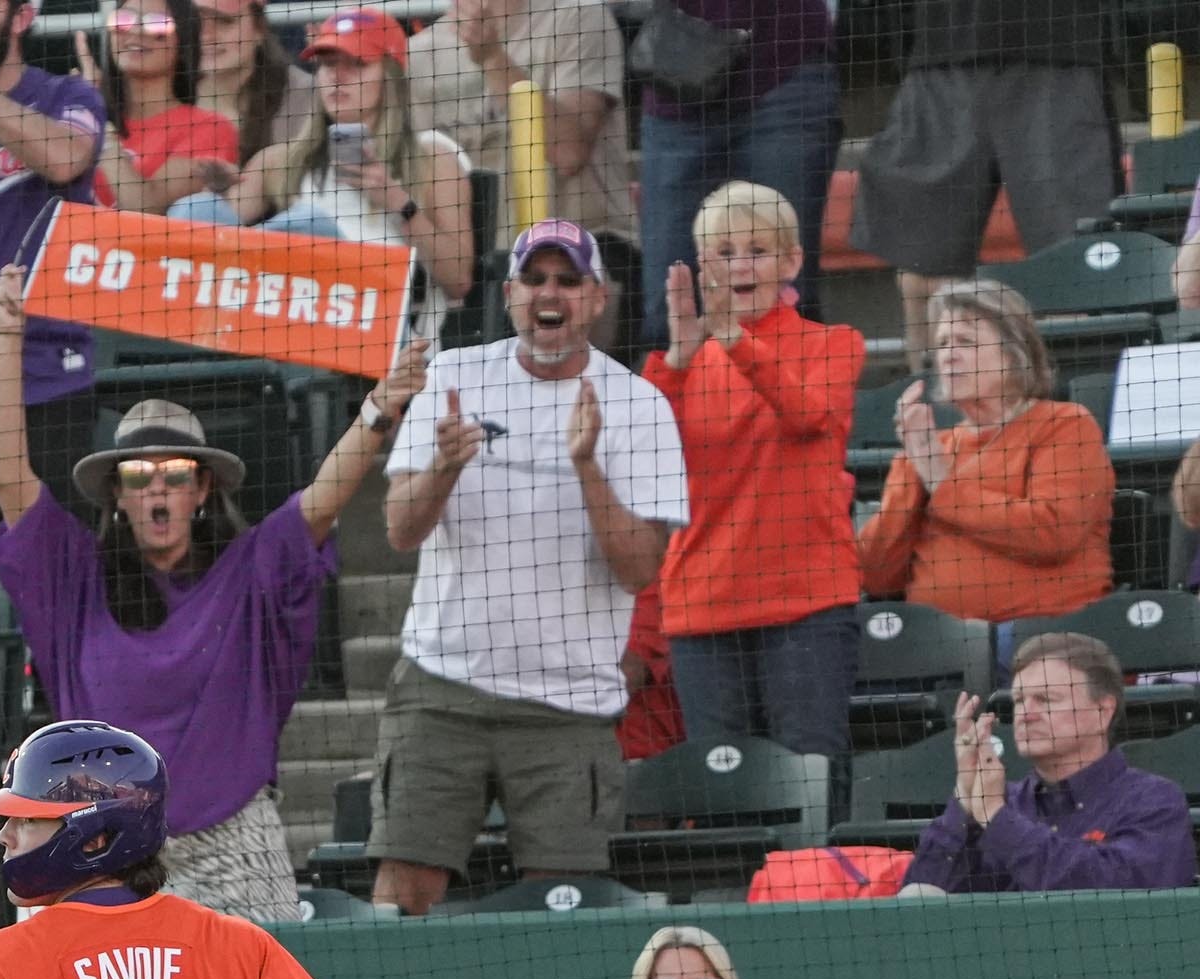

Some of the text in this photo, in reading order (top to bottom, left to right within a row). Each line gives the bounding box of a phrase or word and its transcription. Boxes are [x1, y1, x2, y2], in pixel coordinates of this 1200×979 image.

[64, 242, 378, 332] GO TIGERS!
[71, 804, 98, 819] marucci
